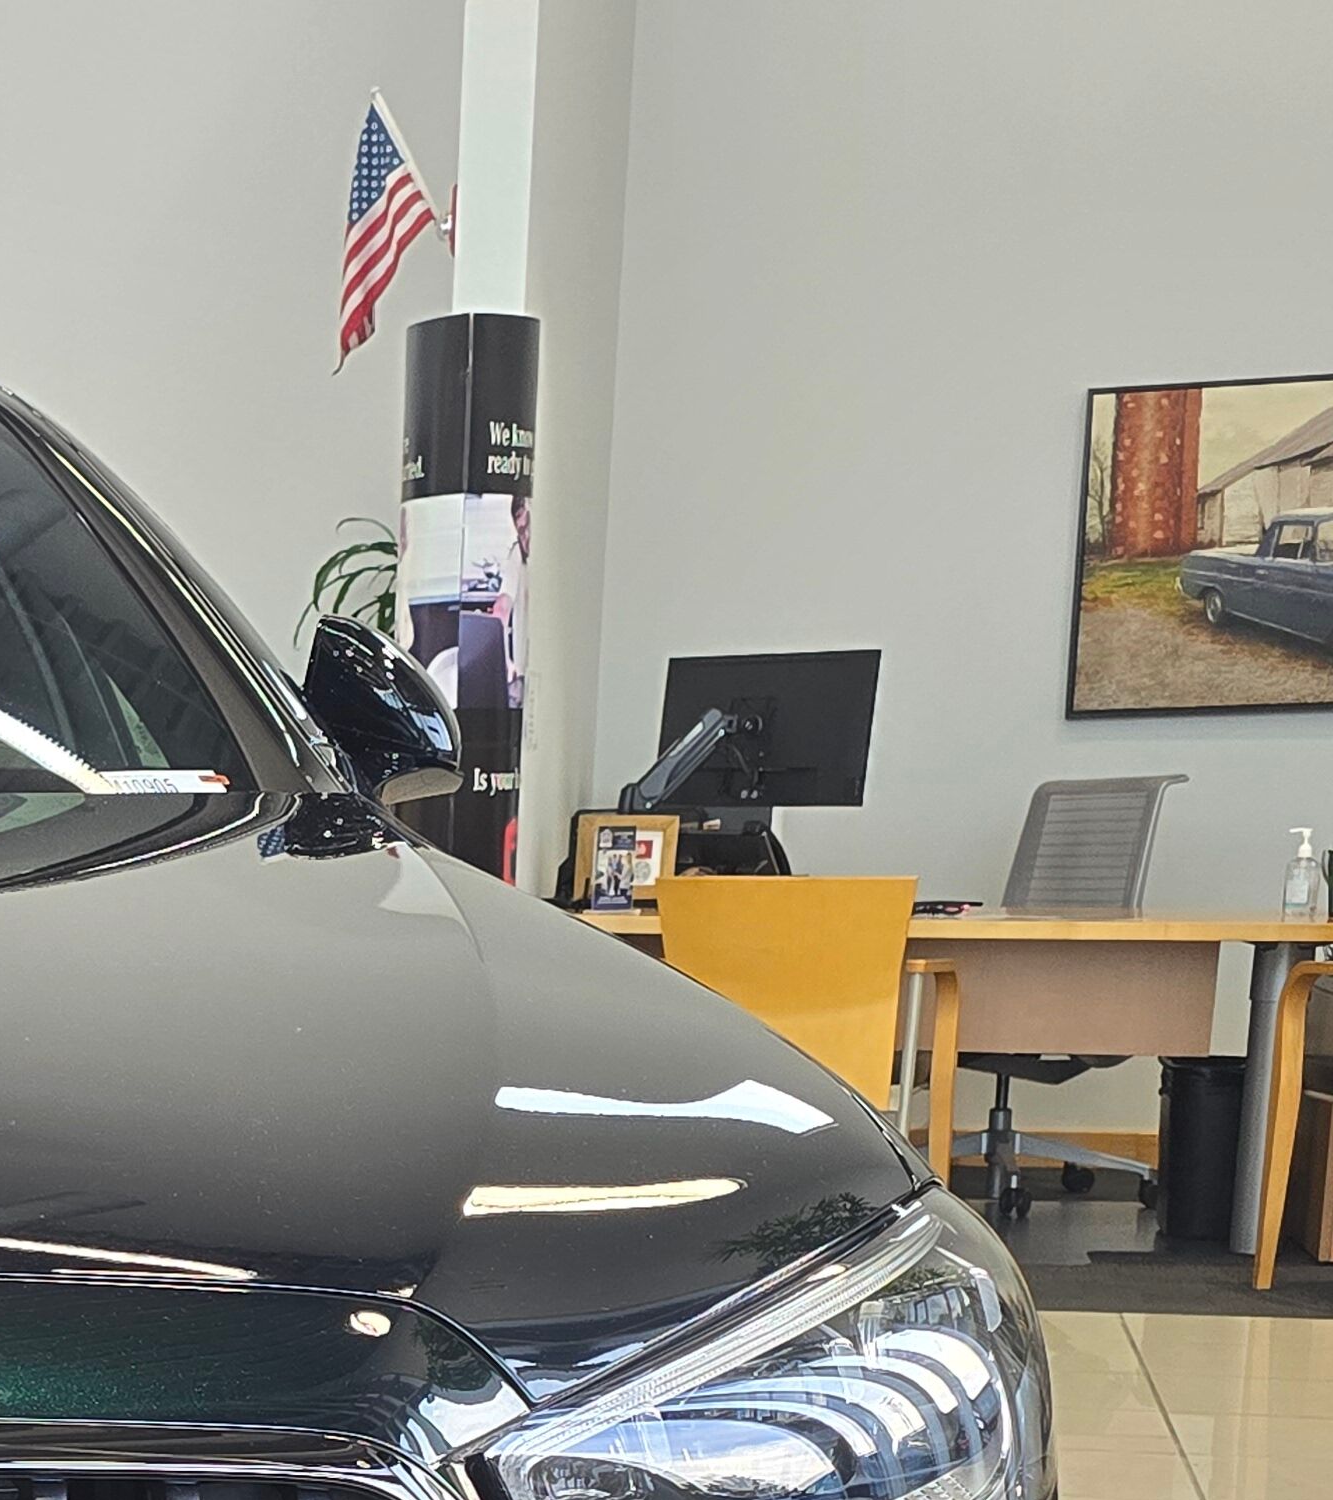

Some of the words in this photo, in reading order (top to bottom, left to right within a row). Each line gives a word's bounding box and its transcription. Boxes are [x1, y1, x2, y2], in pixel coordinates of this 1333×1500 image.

[489, 421, 511, 446] We
[486, 450, 522, 481] ready
[473, 767, 488, 791] Is
